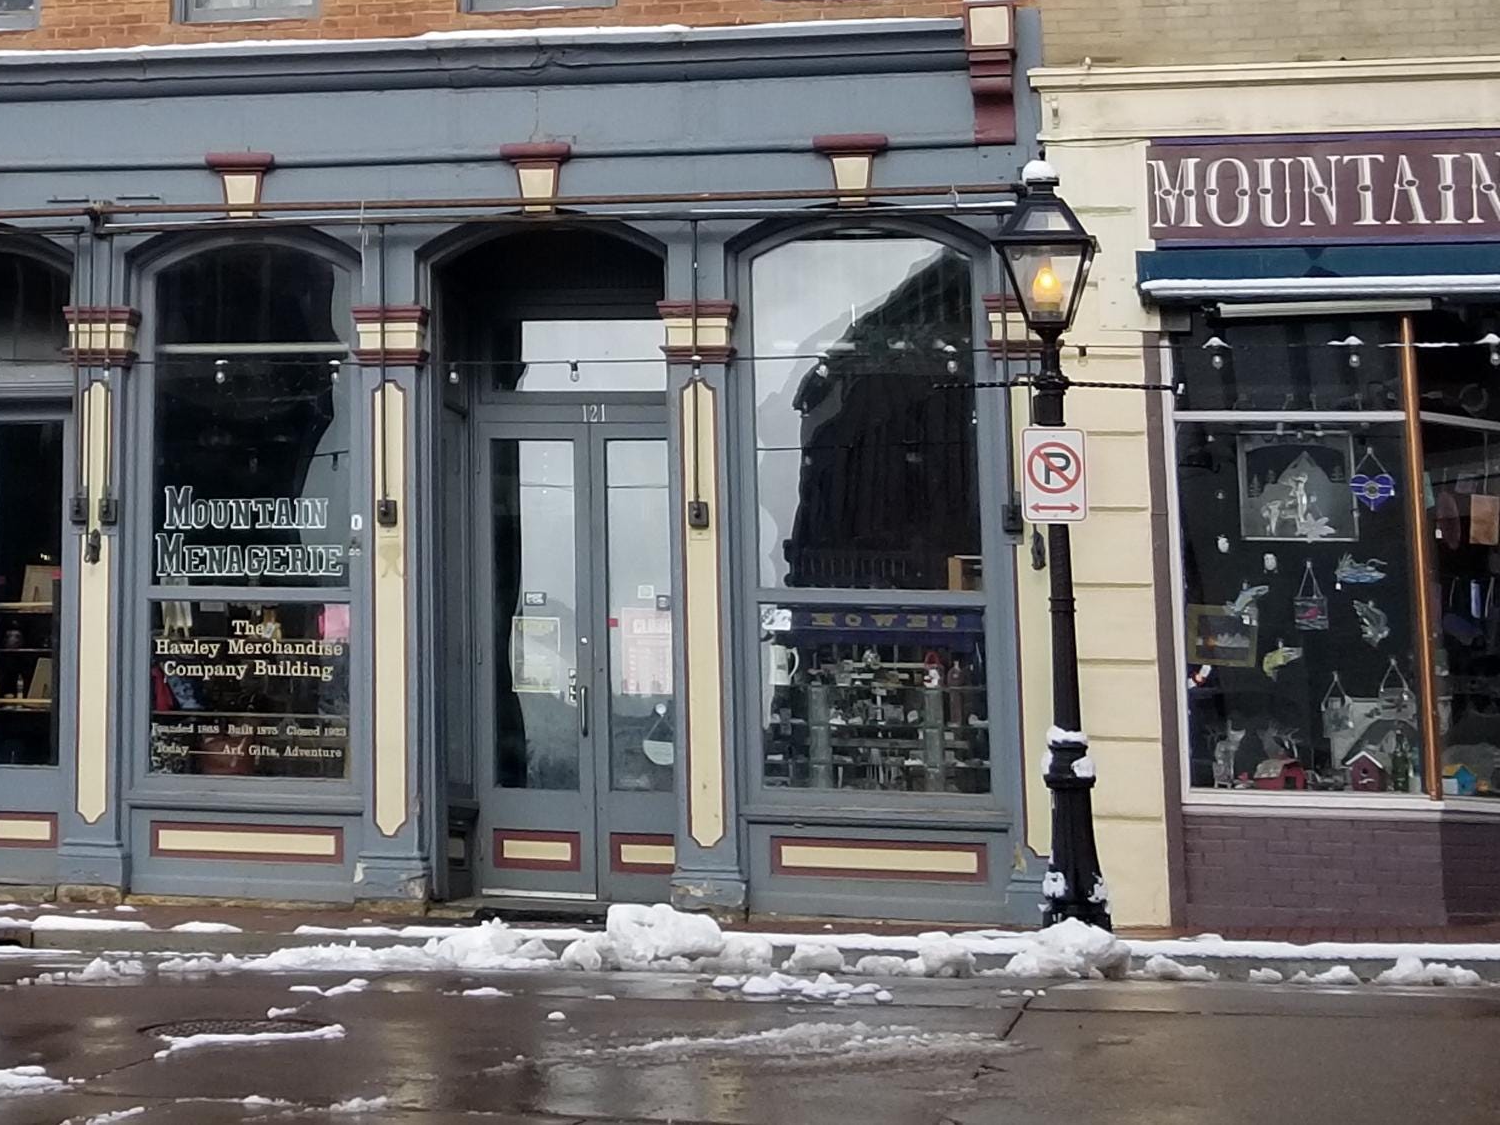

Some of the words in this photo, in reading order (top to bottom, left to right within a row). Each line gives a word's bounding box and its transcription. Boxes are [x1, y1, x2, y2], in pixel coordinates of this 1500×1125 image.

[1147, 153, 1500, 227] MOUNTAIN
[583, 404, 605, 422] 121
[164, 486, 329, 529] MOUNTAIN
[156, 533, 343, 576] MENAGERIE
[231, 620, 263, 635] The
[155, 639, 220, 657] Hawley
[227, 639, 343, 656] Merchandise
[163, 661, 247, 680] Company
[254, 660, 334, 681] Building
[227, 724, 253, 735] Built
[286, 725, 320, 736] Closed
[283, 746, 343, 758] Adventure
